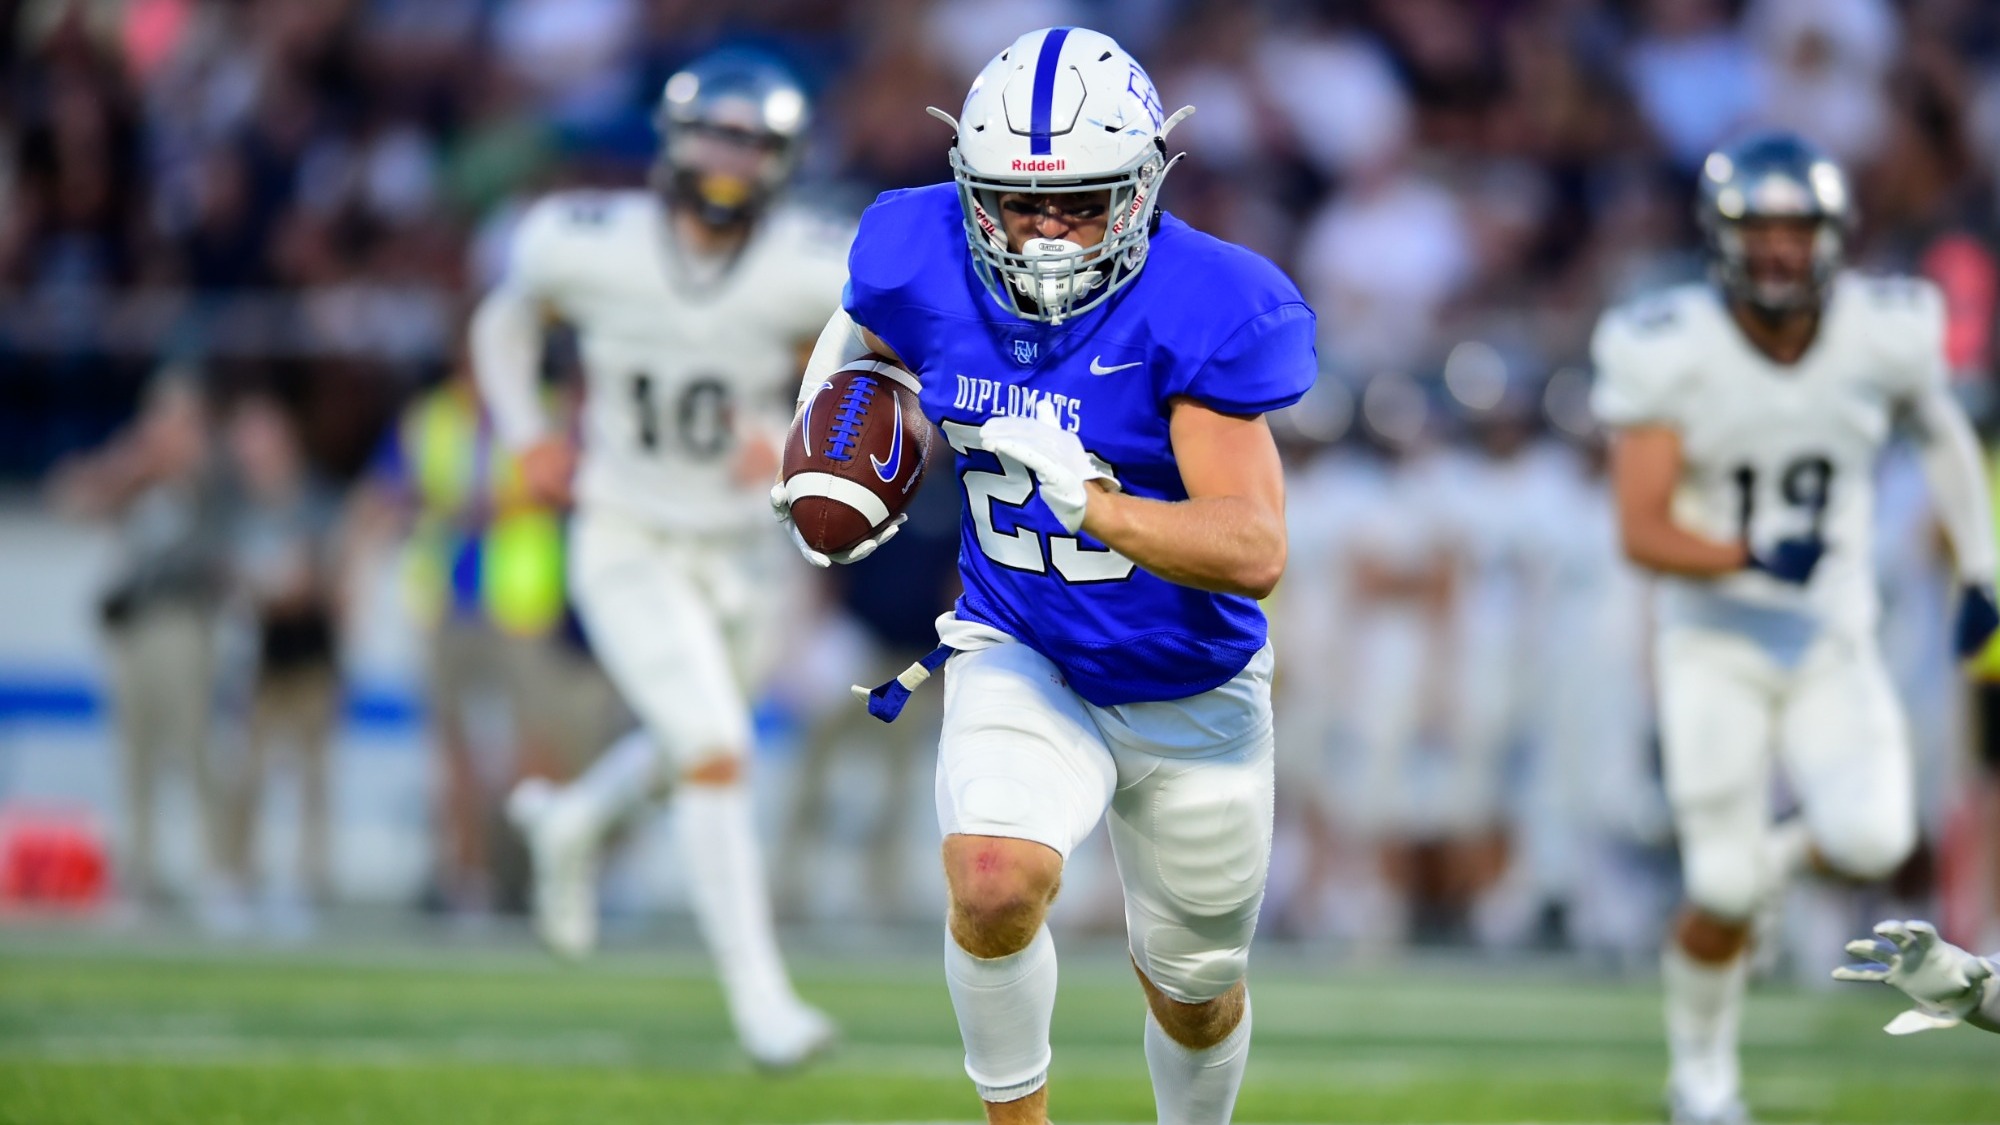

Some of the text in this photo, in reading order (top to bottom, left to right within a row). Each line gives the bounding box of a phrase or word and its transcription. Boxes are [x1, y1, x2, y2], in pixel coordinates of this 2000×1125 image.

[1011, 159, 1066, 171] Riddell
[630, 372, 731, 461] 10
[1733, 456, 1833, 552] 19
